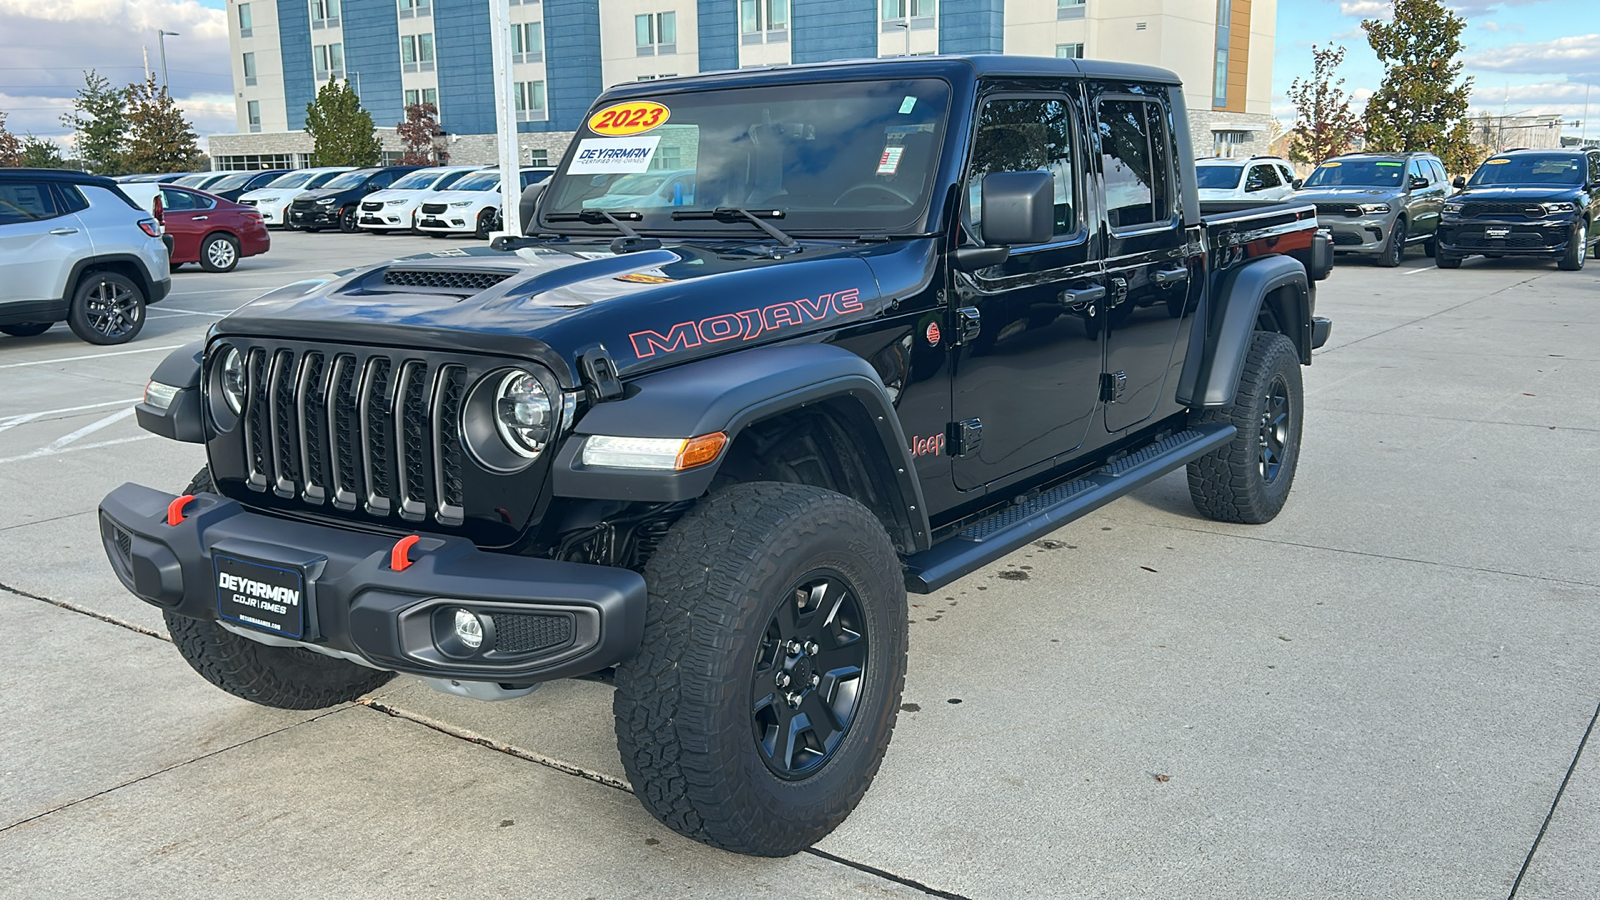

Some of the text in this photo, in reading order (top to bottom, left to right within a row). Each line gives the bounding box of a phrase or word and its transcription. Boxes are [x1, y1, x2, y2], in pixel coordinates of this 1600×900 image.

[594, 107, 664, 129] 2023
[579, 148, 651, 160] DEYARMAN
[628, 288, 864, 359] MOJAVE
[908, 432, 946, 457] Jeep
[219, 572, 299, 606] DEYARMAN
[233, 594, 287, 615] CDJR AMES
